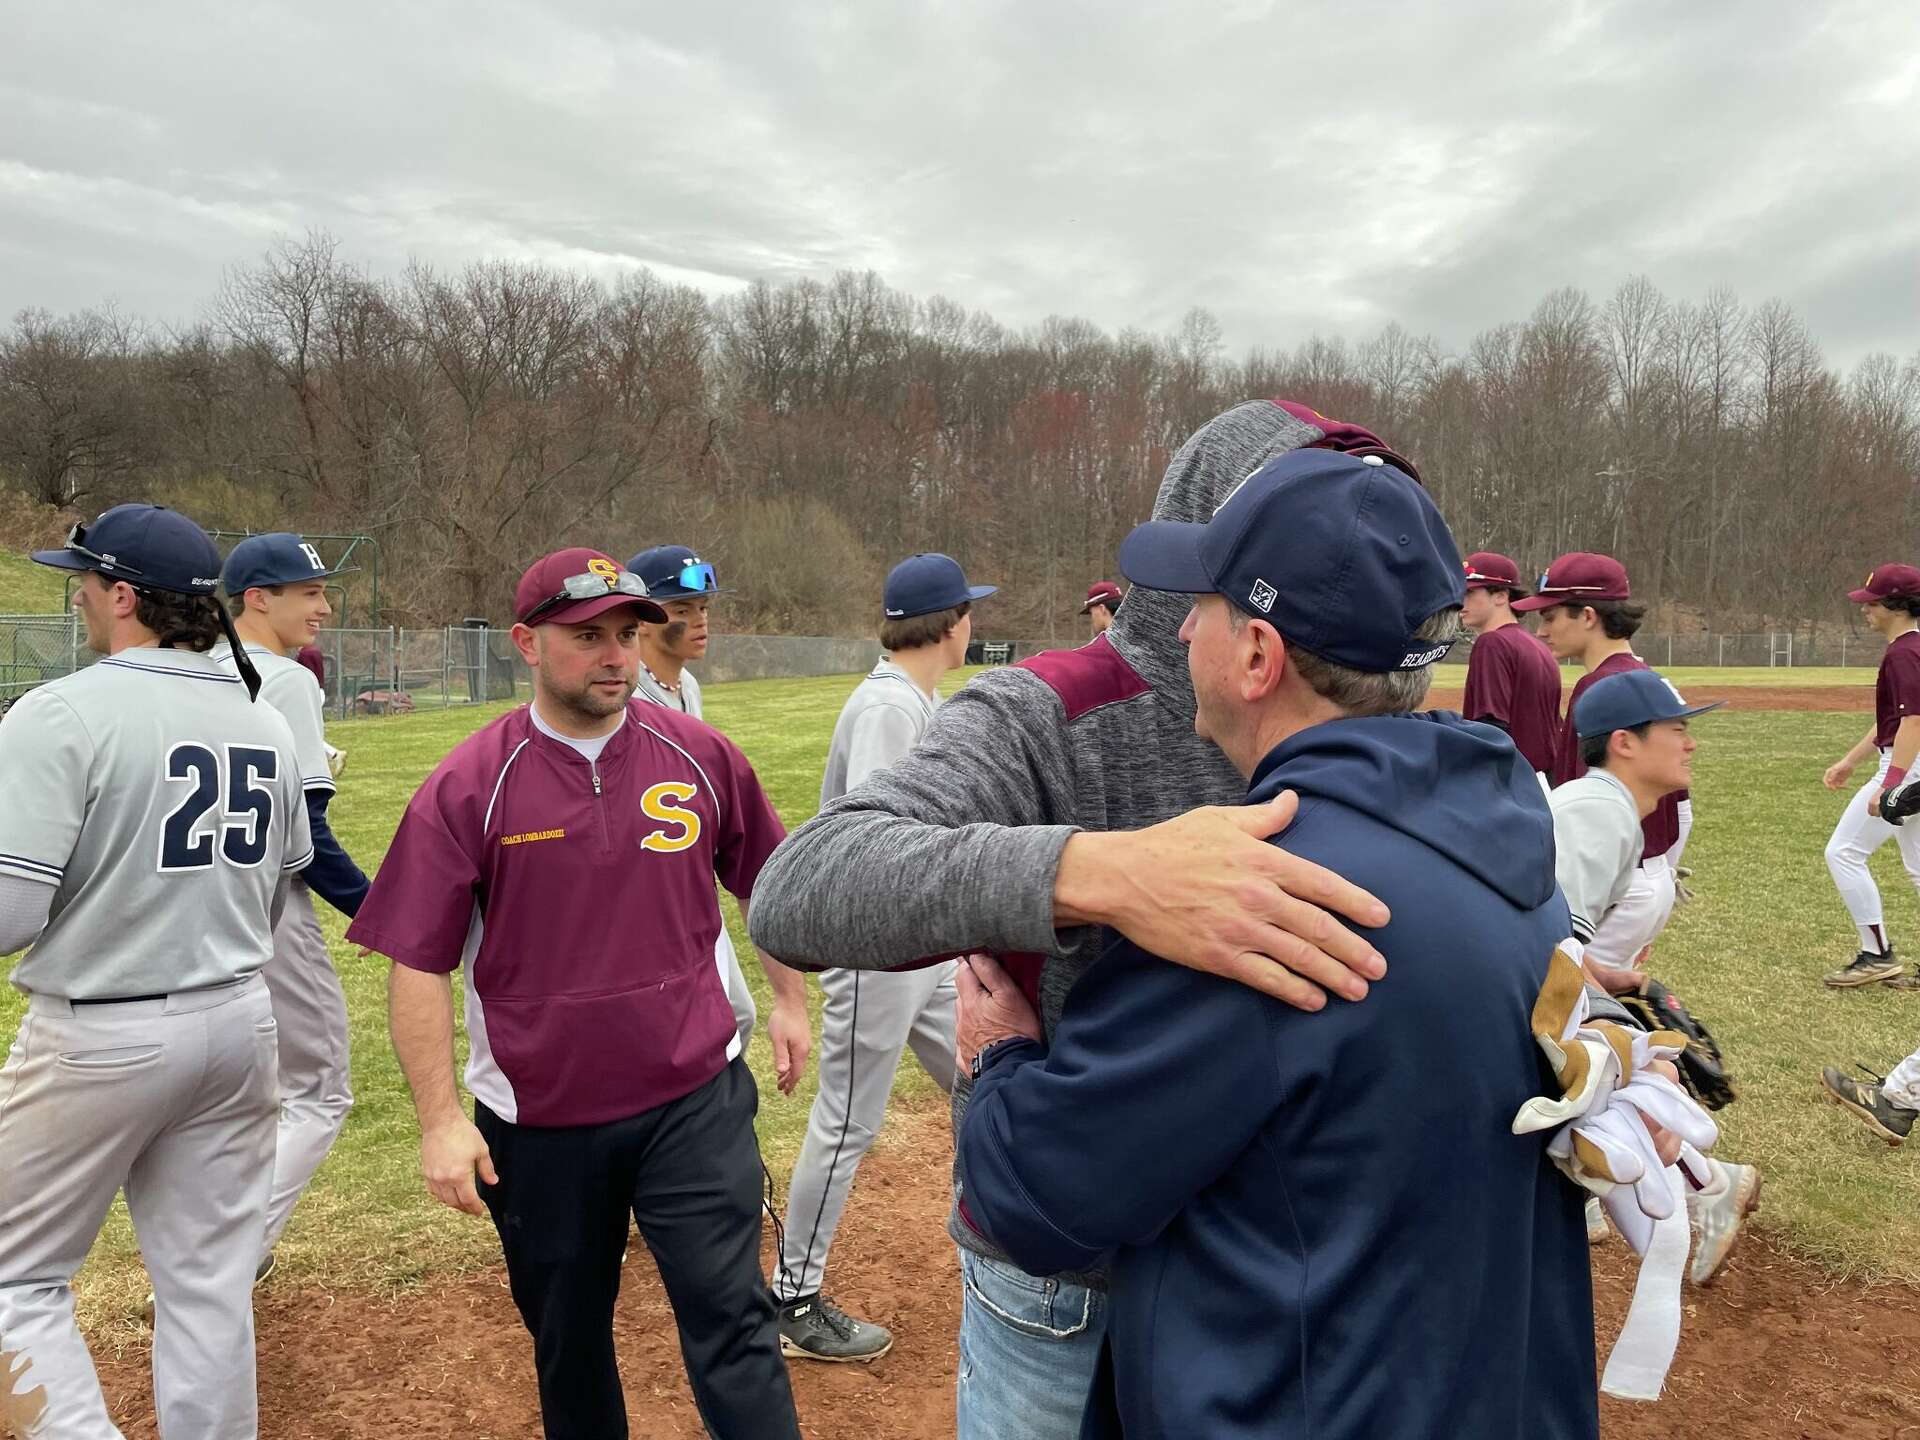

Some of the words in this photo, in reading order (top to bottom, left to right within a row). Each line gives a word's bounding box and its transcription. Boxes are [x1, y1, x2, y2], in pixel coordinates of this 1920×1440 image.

[297, 543, 326, 570] H
[588, 559, 617, 588] S
[157, 741, 280, 872] 25
[640, 781, 701, 852] S
[501, 835, 522, 846] COACH
